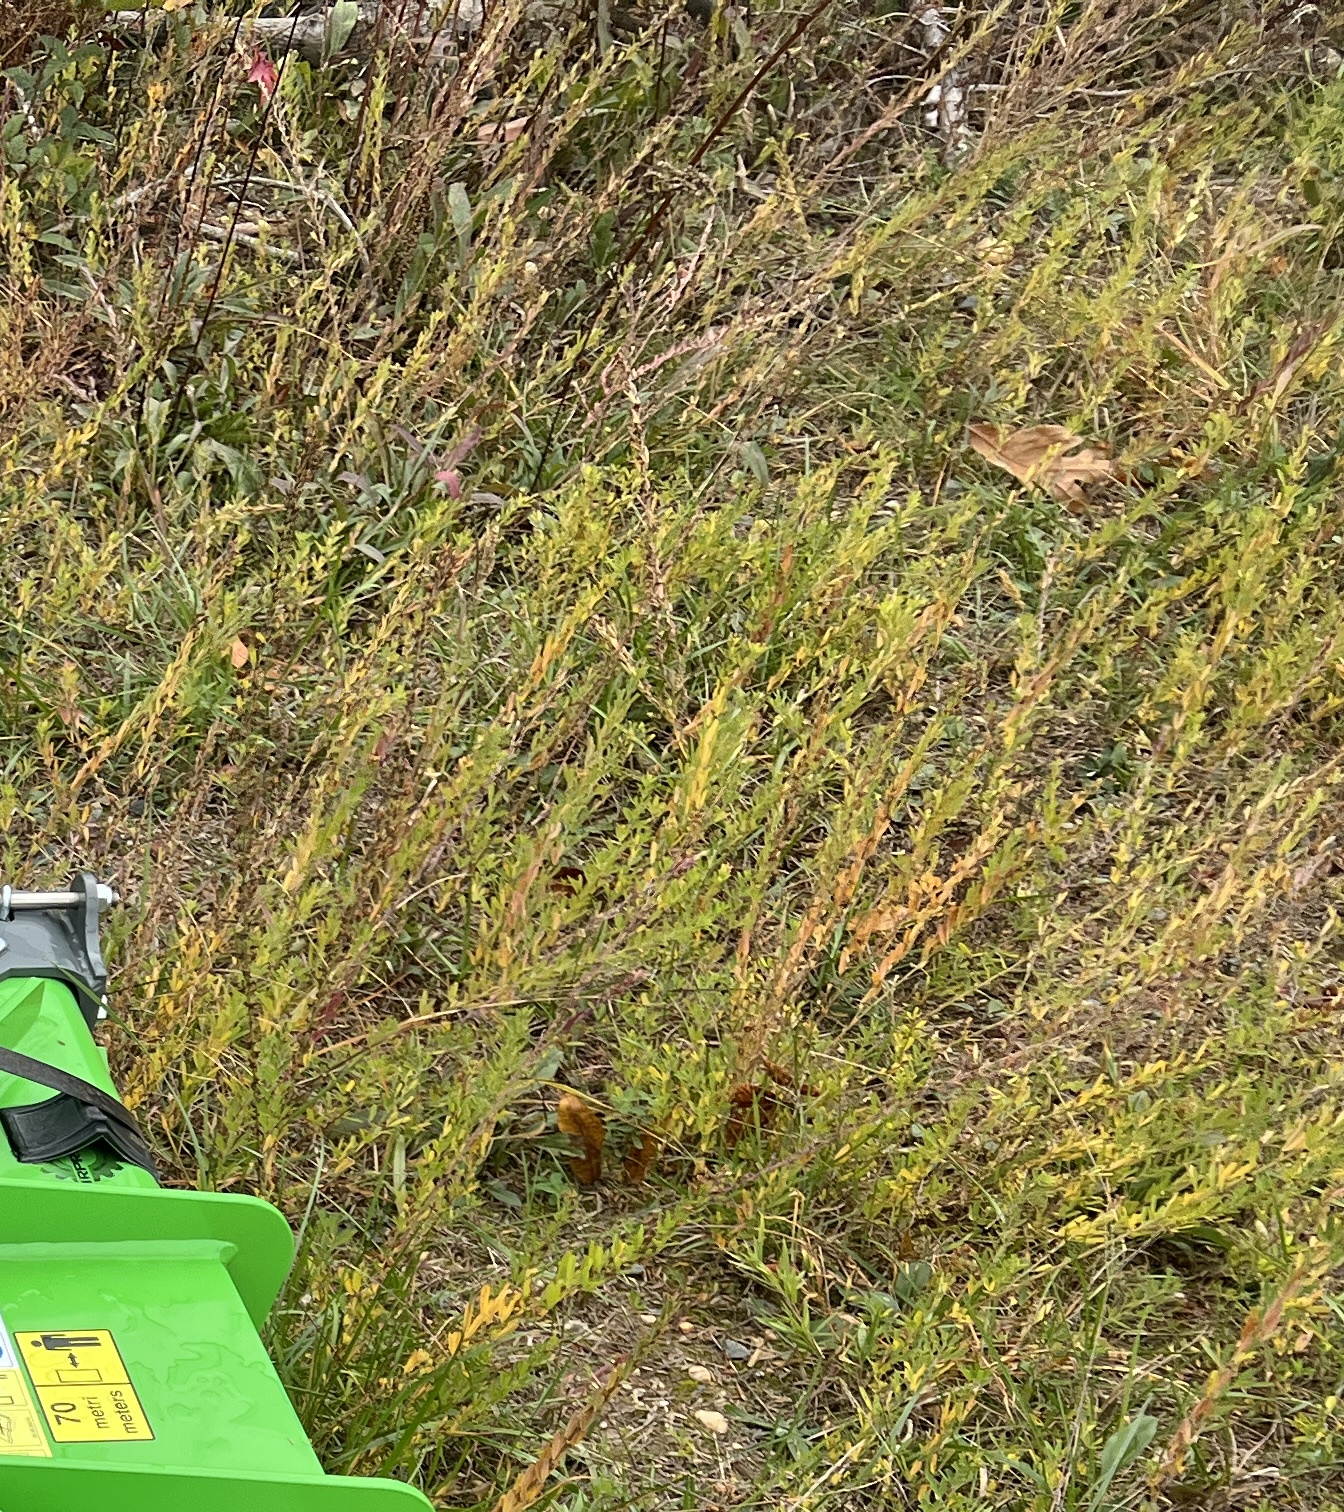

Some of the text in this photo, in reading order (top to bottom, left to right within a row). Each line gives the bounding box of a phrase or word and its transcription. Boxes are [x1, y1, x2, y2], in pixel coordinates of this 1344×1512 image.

[50, 1402, 81, 1426] 70
[82, 1396, 111, 1429] metri
[110, 1390, 139, 1434] meters
